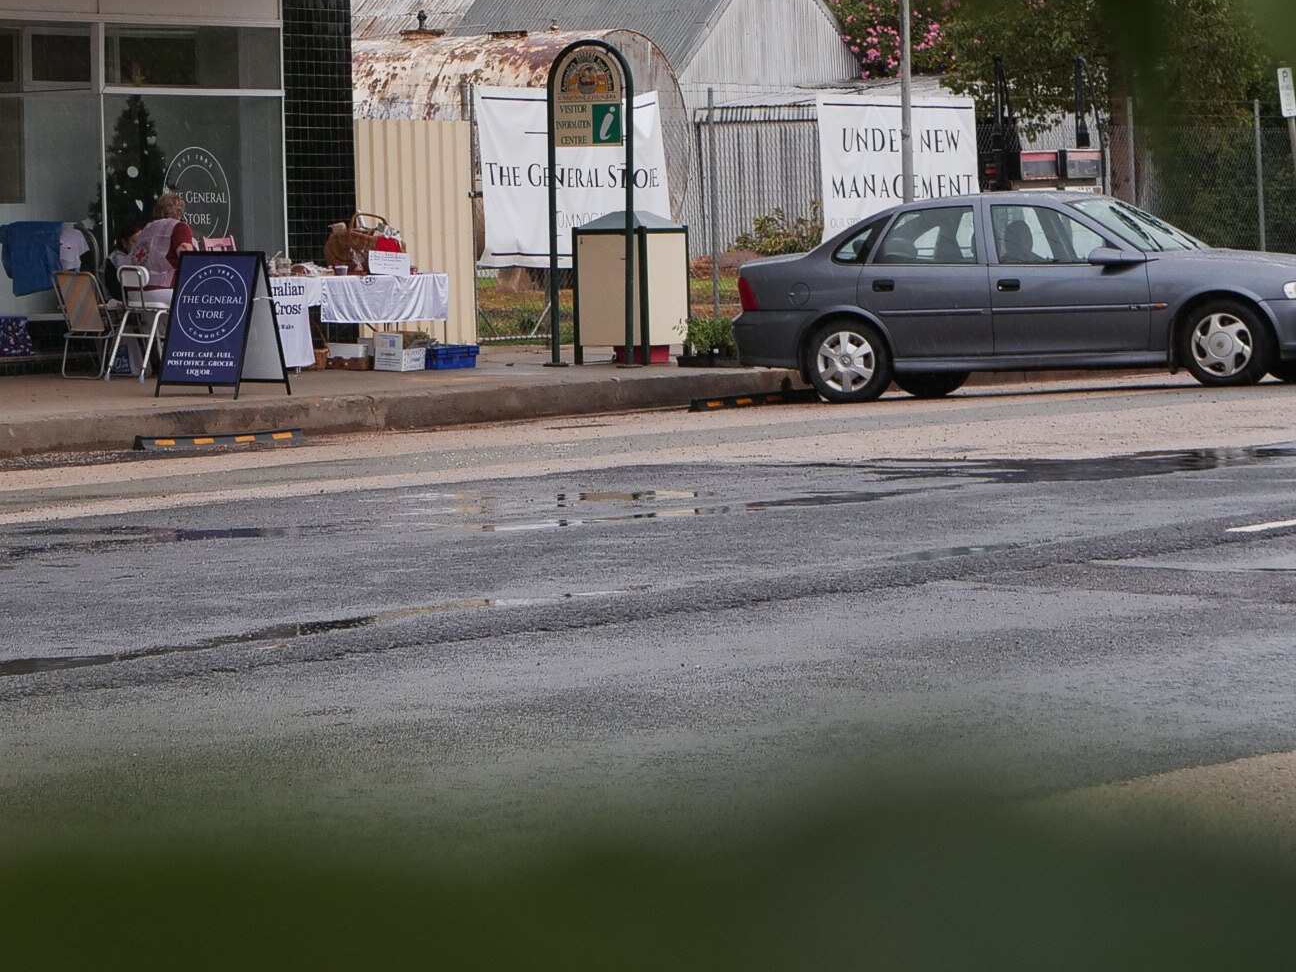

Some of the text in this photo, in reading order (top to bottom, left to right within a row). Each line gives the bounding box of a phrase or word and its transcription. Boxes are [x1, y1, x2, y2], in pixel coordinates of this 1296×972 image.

[559, 104, 588, 114] VISITOR
[555, 120, 592, 129] INFORMATION
[560, 135, 588, 145] CENTRE
[842, 128, 960, 153] UNDE NEW
[485, 162, 522, 187] THE
[527, 163, 604, 188] GENERAL
[185, 190, 227, 204] GENERAL
[184, 212, 211, 225] STORE
[198, 269, 213, 279] EST
[271, 282, 305, 297] ralian
[182, 294, 243, 304] THE GENERAL
[196, 309, 225, 319] STORE
[274, 301, 302, 316] Cross
